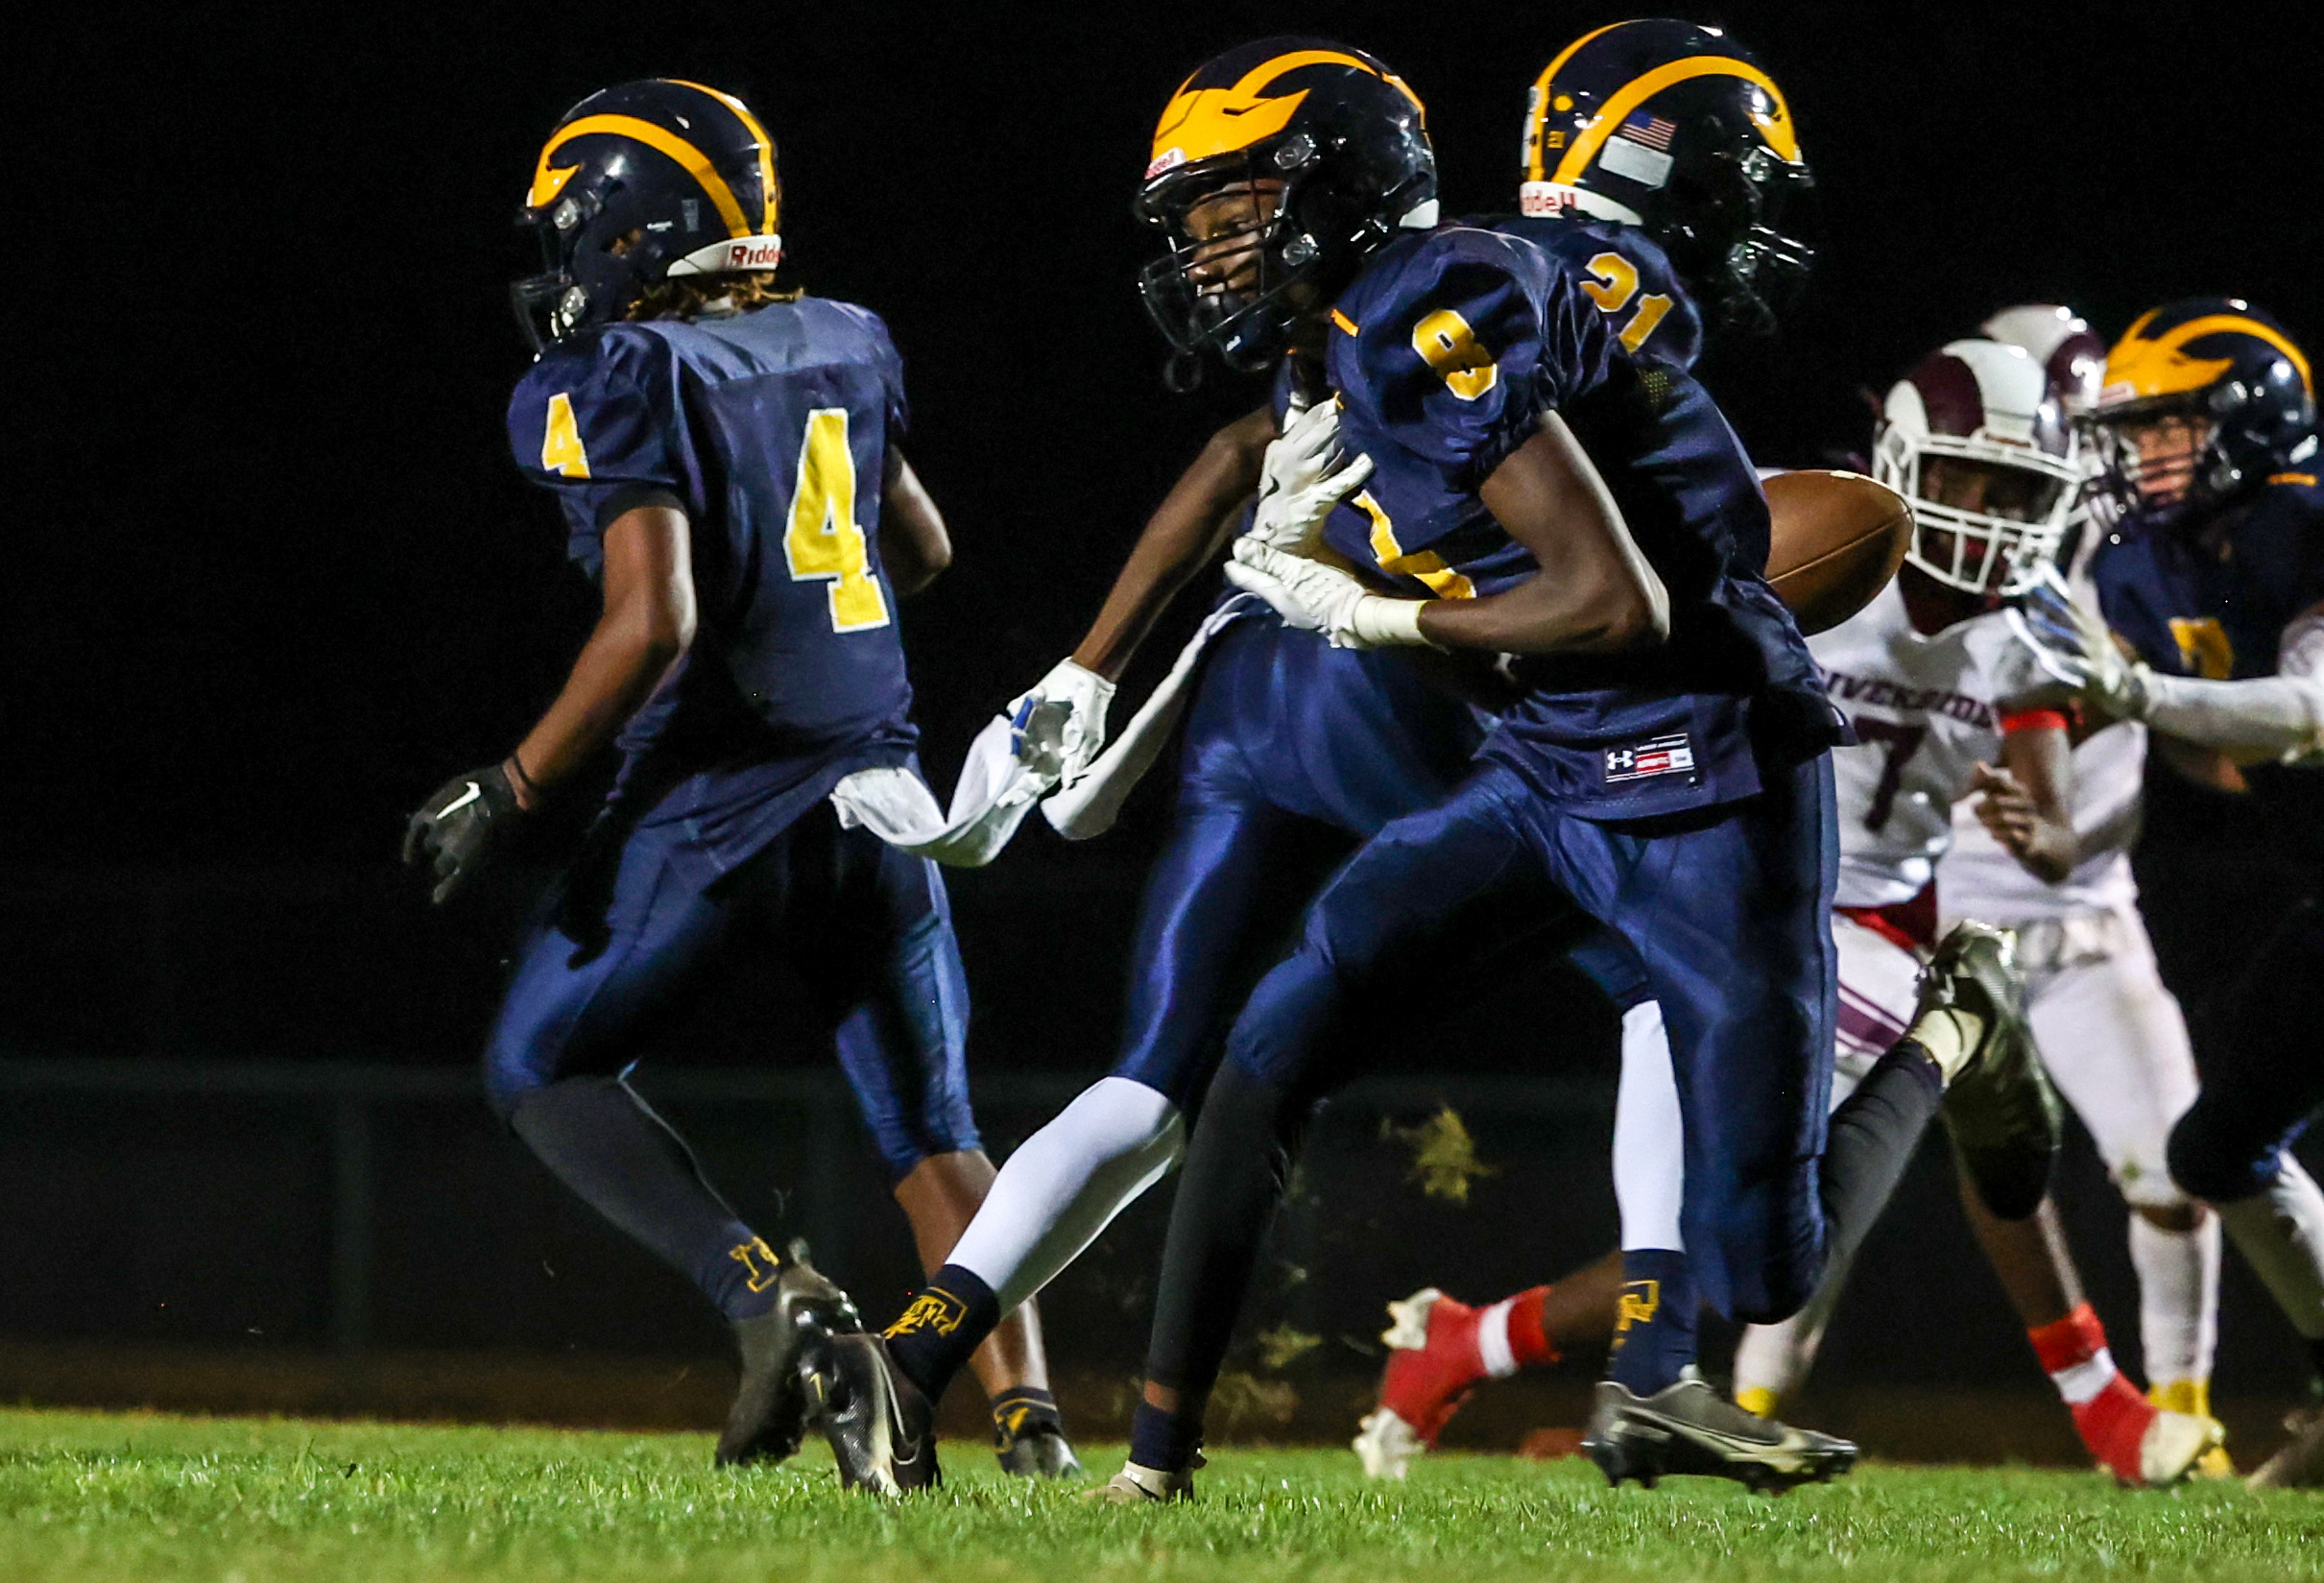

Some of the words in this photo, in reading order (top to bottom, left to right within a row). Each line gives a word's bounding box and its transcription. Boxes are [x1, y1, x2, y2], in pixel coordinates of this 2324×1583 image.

[1579, 252, 1673, 353] 21
[1412, 309, 1497, 400] 8
[543, 393, 591, 479] 4
[783, 408, 890, 633] 4
[1855, 715, 1926, 831] 7
